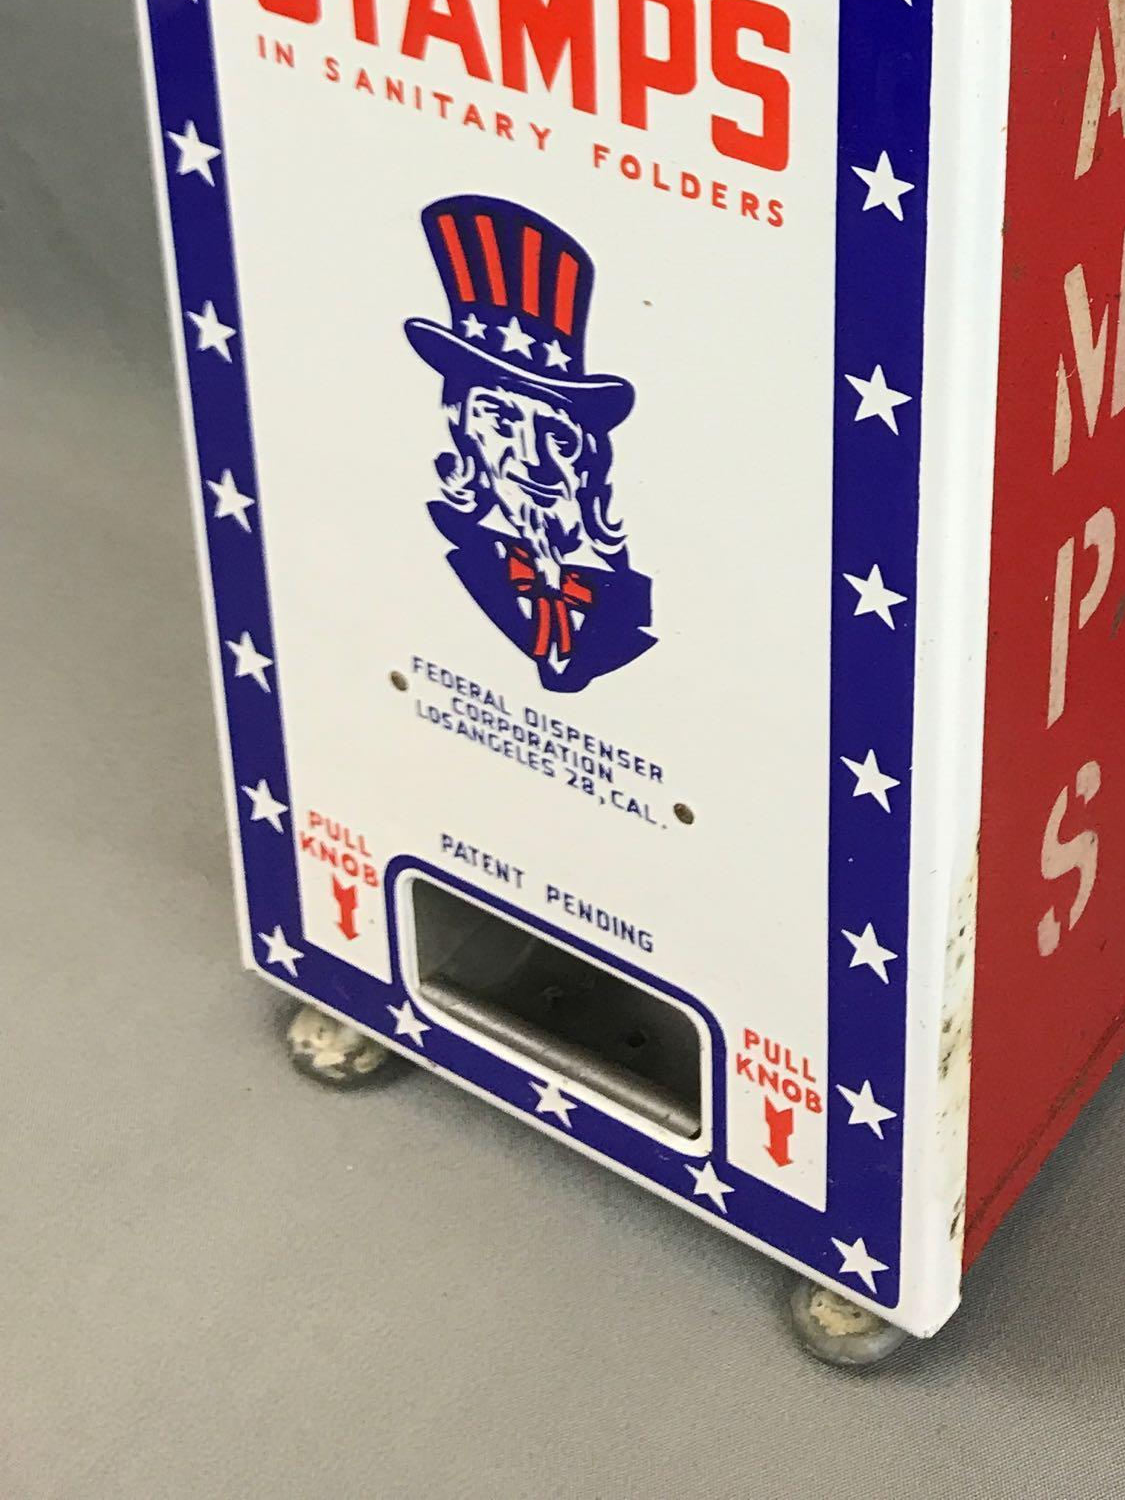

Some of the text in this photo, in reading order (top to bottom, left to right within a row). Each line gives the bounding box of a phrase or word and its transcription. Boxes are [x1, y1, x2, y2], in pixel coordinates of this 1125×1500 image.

[257, 34, 786, 228] IN SANITARY FOLDERS
[411, 655, 664, 784] FEDERAL DISPENSER
[451, 696, 614, 784] CORPORATION
[300, 830, 379, 888] KNOB
[308, 809, 372, 859] PULL
[440, 833, 655, 954] PATENT PENDING
[736, 1052, 823, 1114] KNOB
[744, 1027, 817, 1083] PULL
